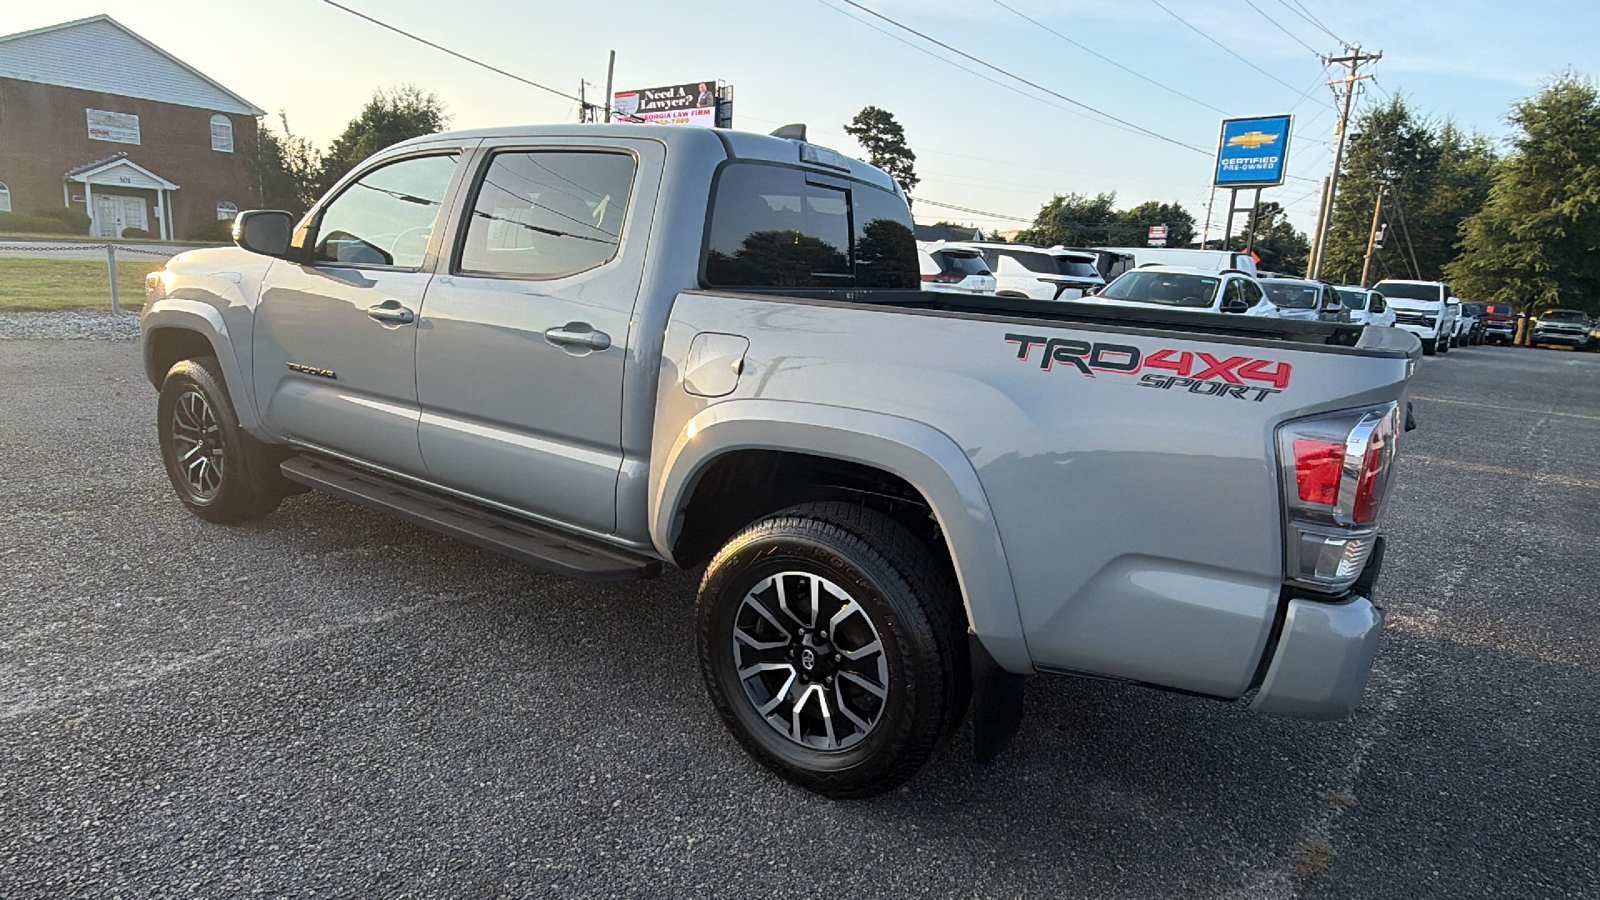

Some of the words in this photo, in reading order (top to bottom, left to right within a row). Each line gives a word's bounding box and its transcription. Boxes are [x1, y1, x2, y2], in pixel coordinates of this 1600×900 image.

[645, 88, 674, 99] Need
[677, 87, 686, 97] A
[640, 95, 693, 109] Lawyer?
[1221, 156, 1278, 165] CERTIFIED
[1223, 163, 1274, 171] PRE-OWNED
[1004, 333, 1143, 378] TRD
[1143, 349, 1293, 389] 4X4
[1136, 373, 1283, 403] SPORT
